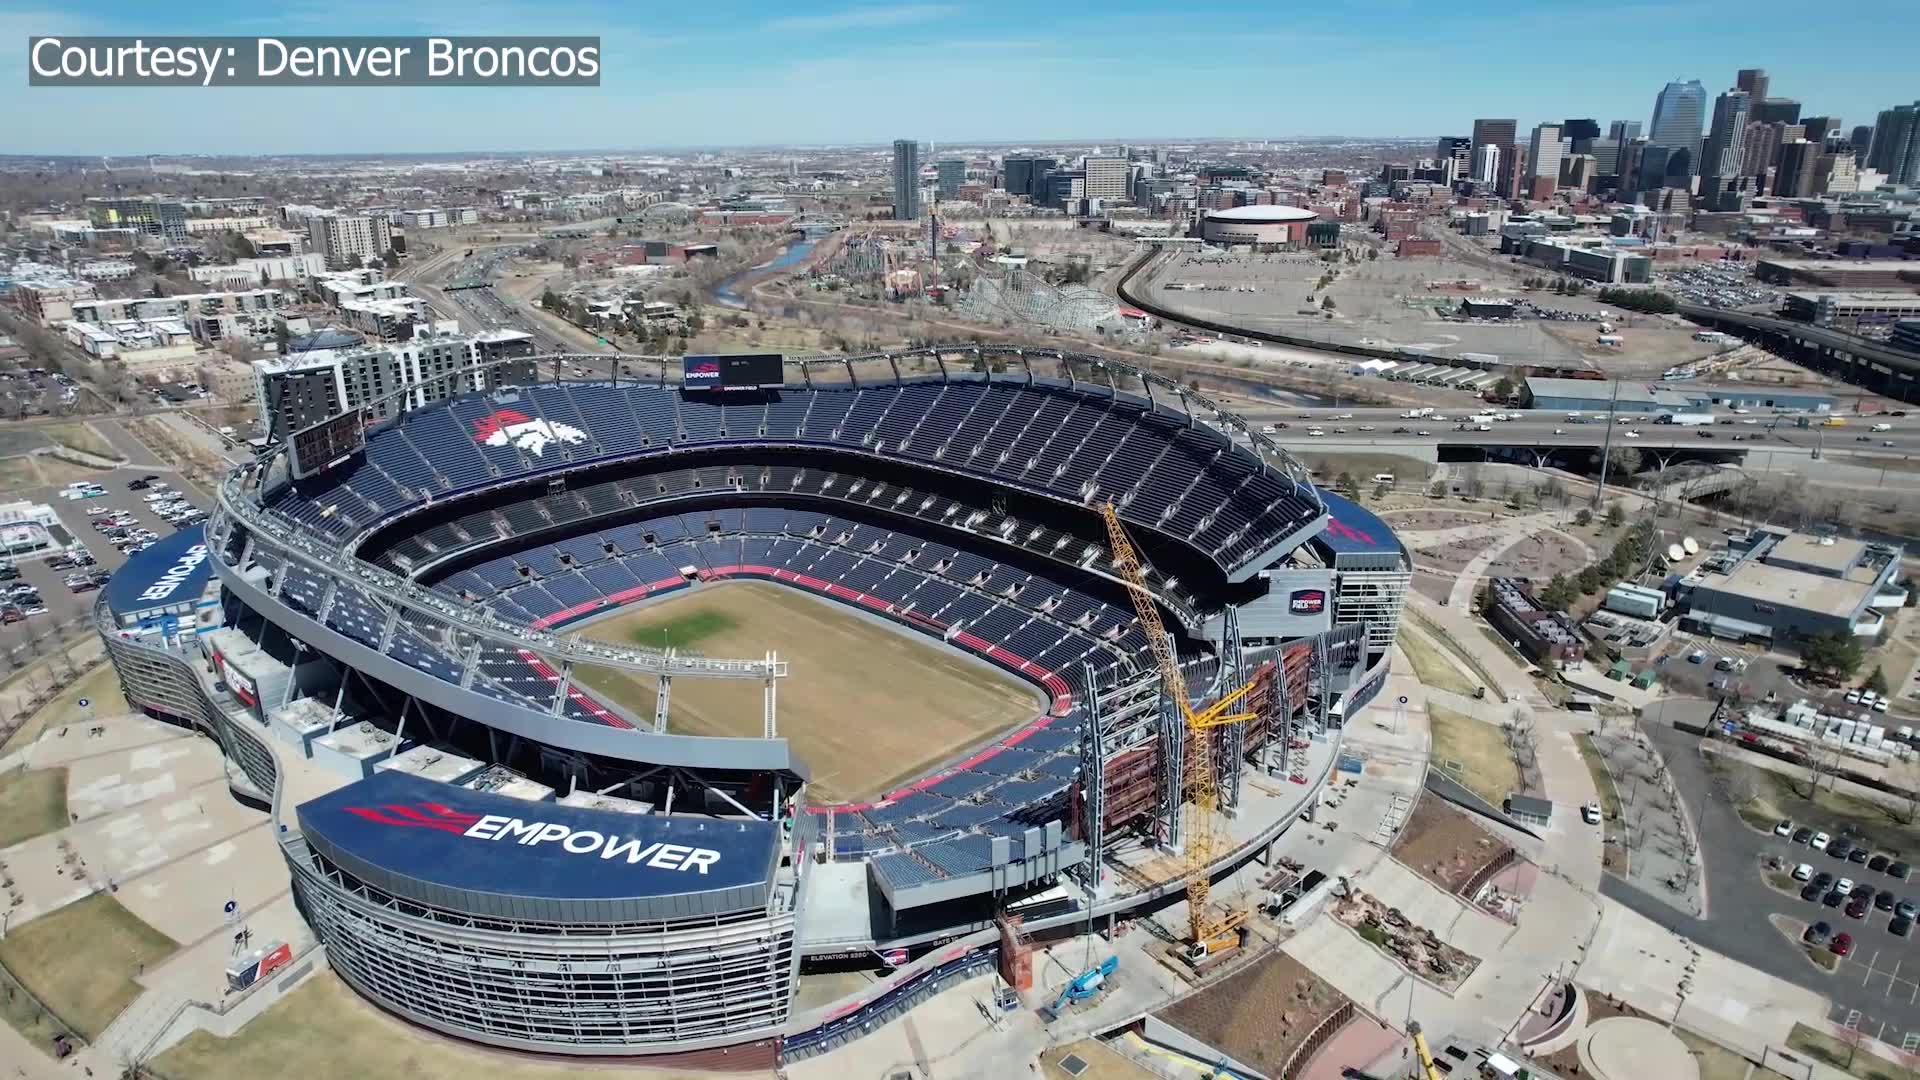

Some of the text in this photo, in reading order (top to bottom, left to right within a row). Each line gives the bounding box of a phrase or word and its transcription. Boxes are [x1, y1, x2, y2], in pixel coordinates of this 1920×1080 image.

[686, 371, 719, 379] EMPOWER
[463, 814, 721, 875] EMPOWER
[810, 953, 849, 961] ELEVATION
